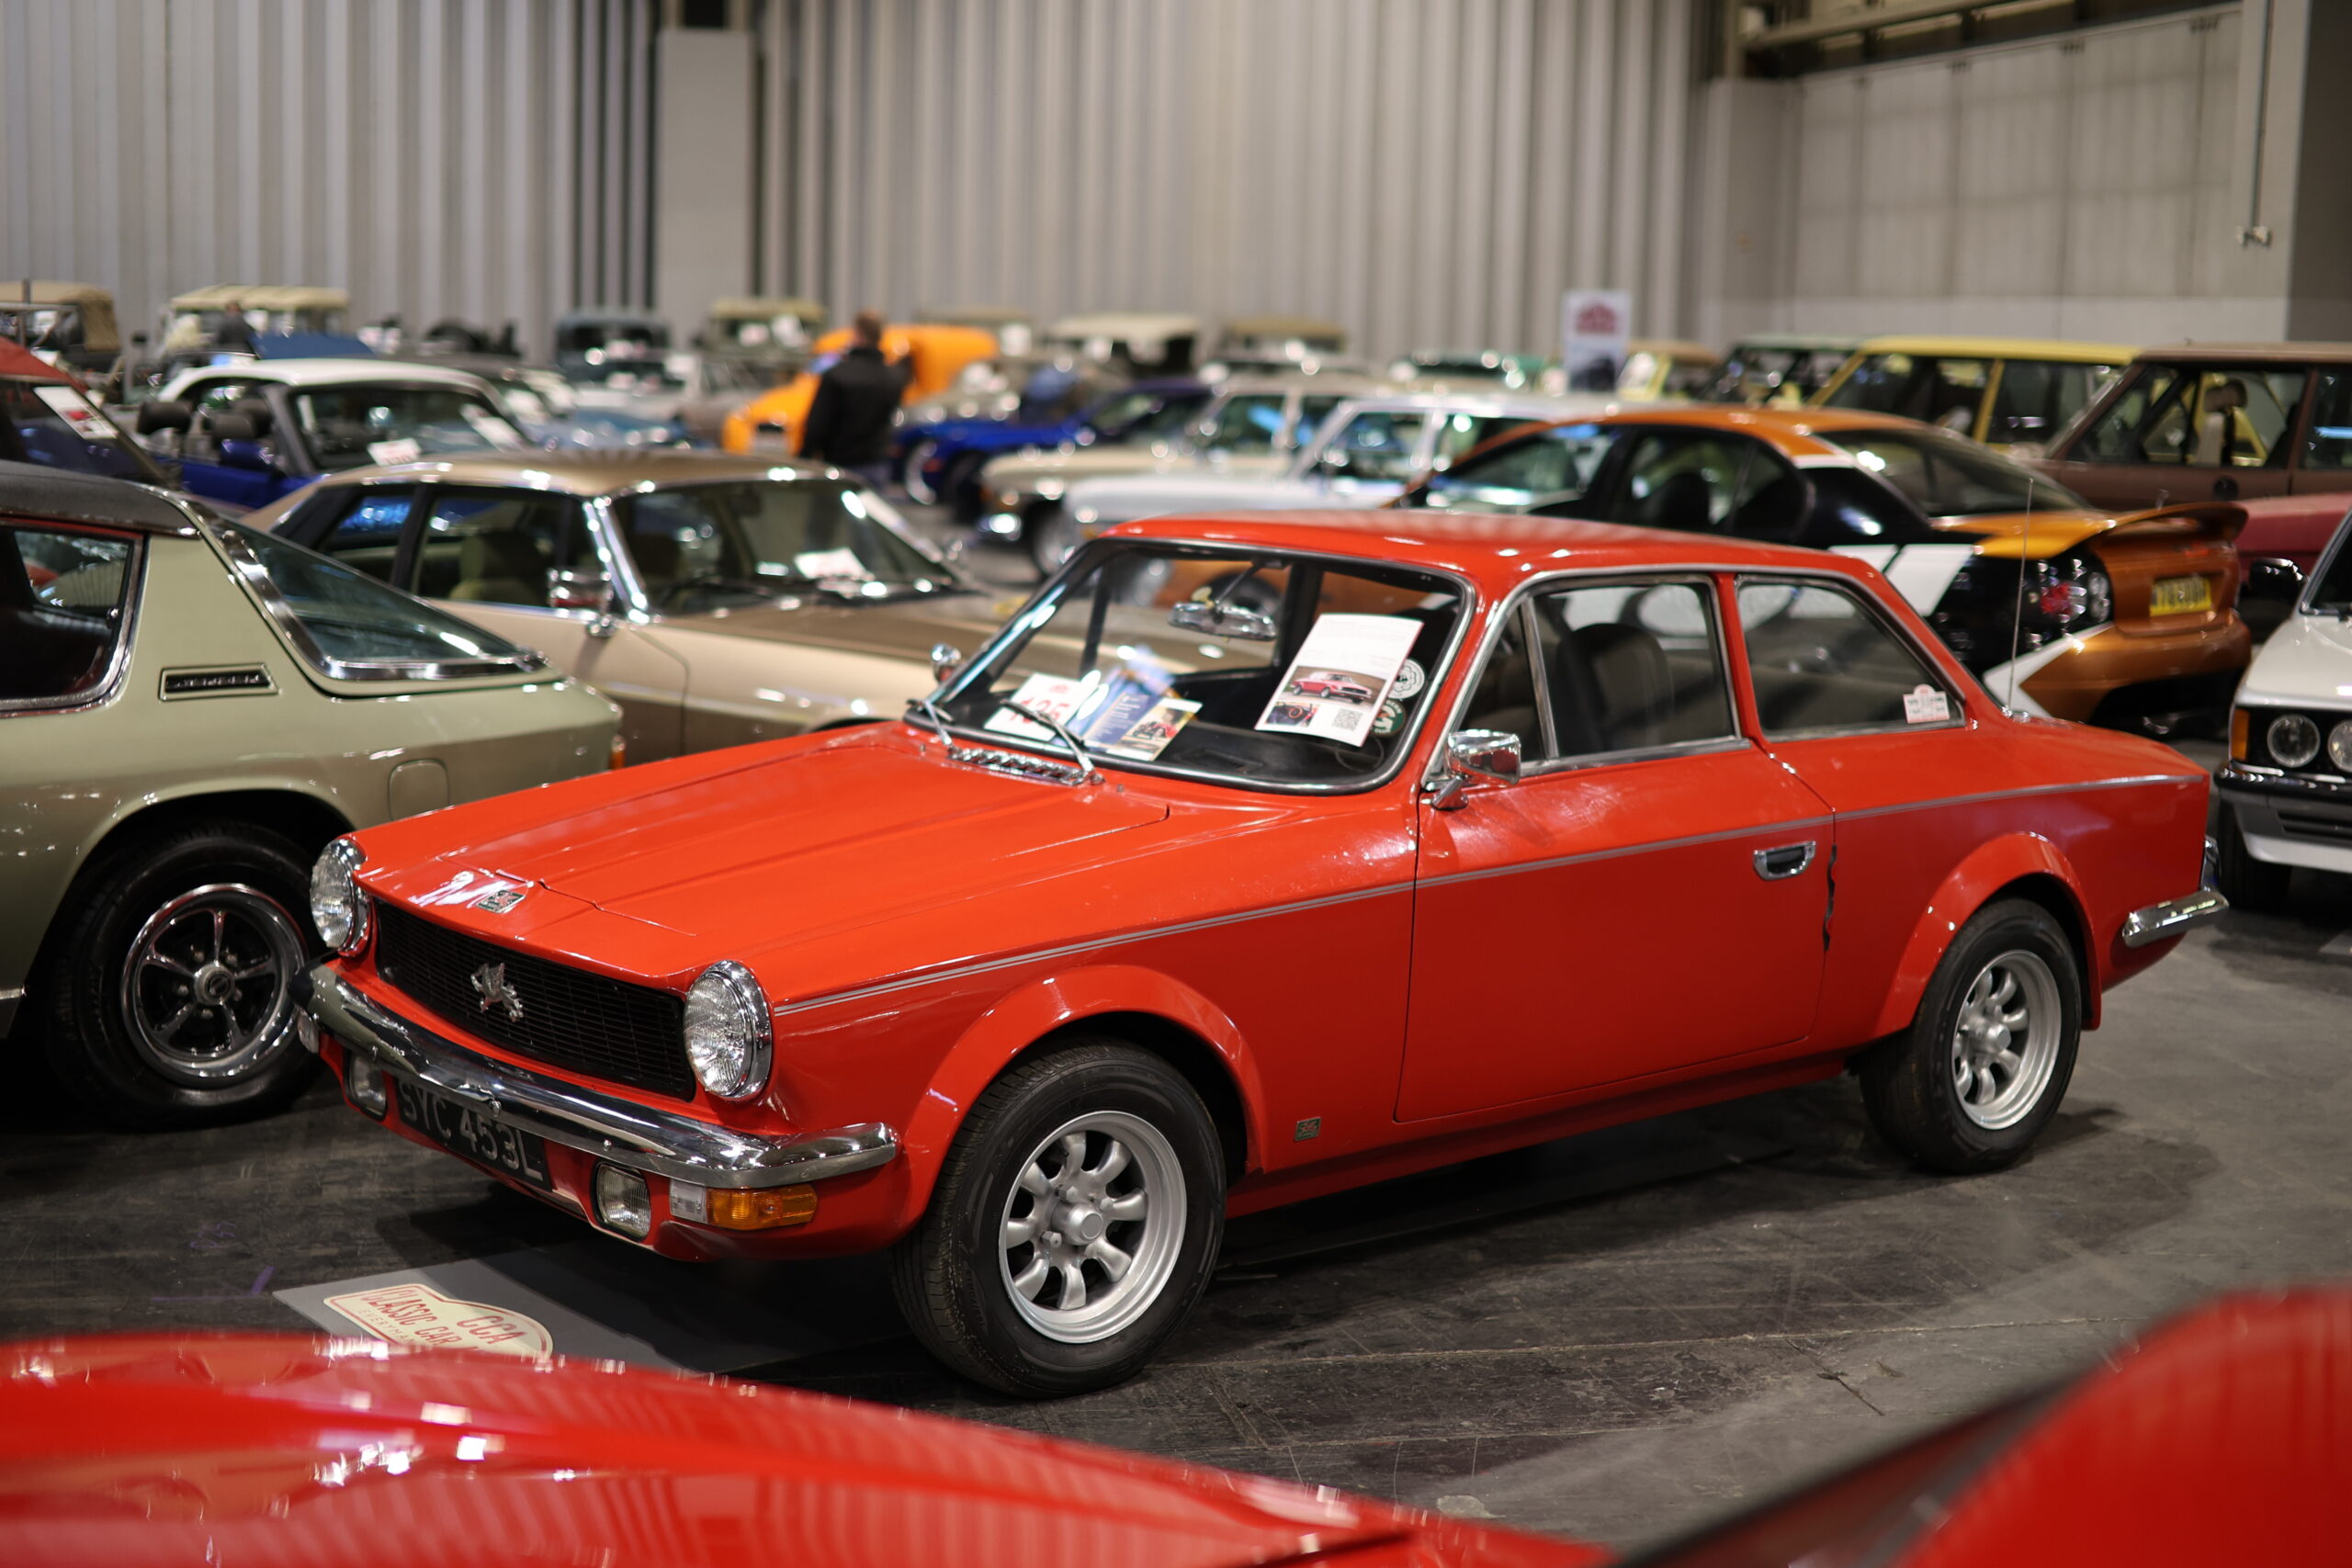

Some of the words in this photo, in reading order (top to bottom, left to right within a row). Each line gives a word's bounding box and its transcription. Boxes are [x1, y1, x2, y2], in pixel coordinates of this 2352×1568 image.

[399, 1079, 452, 1140] SYC
[460, 1108, 544, 1181] 453L
[361, 1289, 438, 1325] CLASSIC
[414, 1326, 462, 1346] CAR
[457, 1315, 526, 1345] CCA
